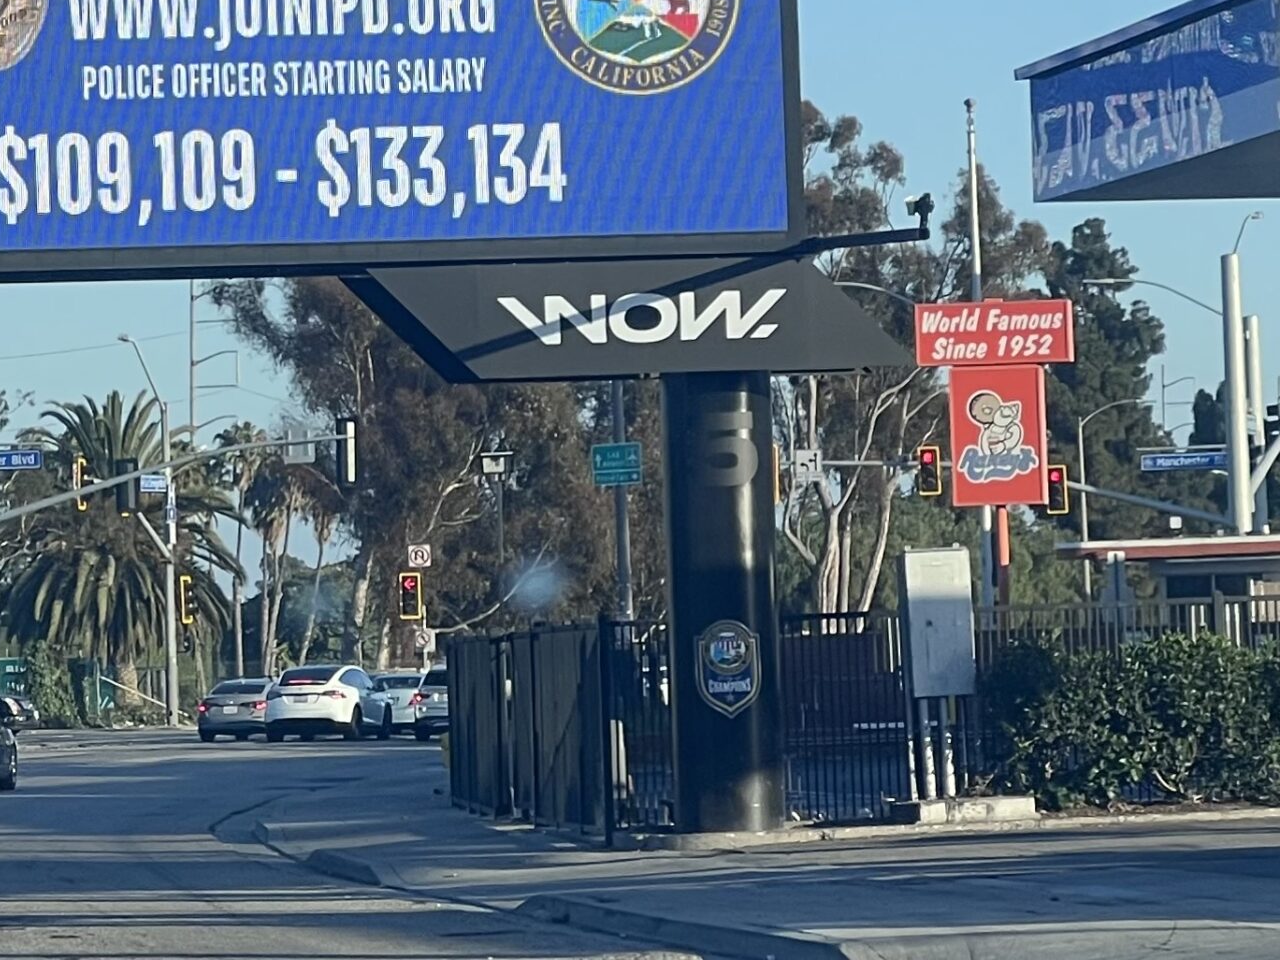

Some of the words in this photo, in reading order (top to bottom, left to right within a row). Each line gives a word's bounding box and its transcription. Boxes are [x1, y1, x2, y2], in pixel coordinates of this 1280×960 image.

[83, 65, 164, 100] POLICE
[171, 62, 266, 98] OFFICER
[273, 59, 390, 96] STARTING
[397, 57, 486, 94] SALARY
[571, 46, 705, 87] CALIFORNIA
[316, 119, 567, 218] $133,134
[922, 308, 980, 333] World
[986, 309, 1063, 332] Famous
[932, 337, 987, 360] Since
[997, 334, 1053, 357] 1952
[11, 454, 35, 465] Blvd
